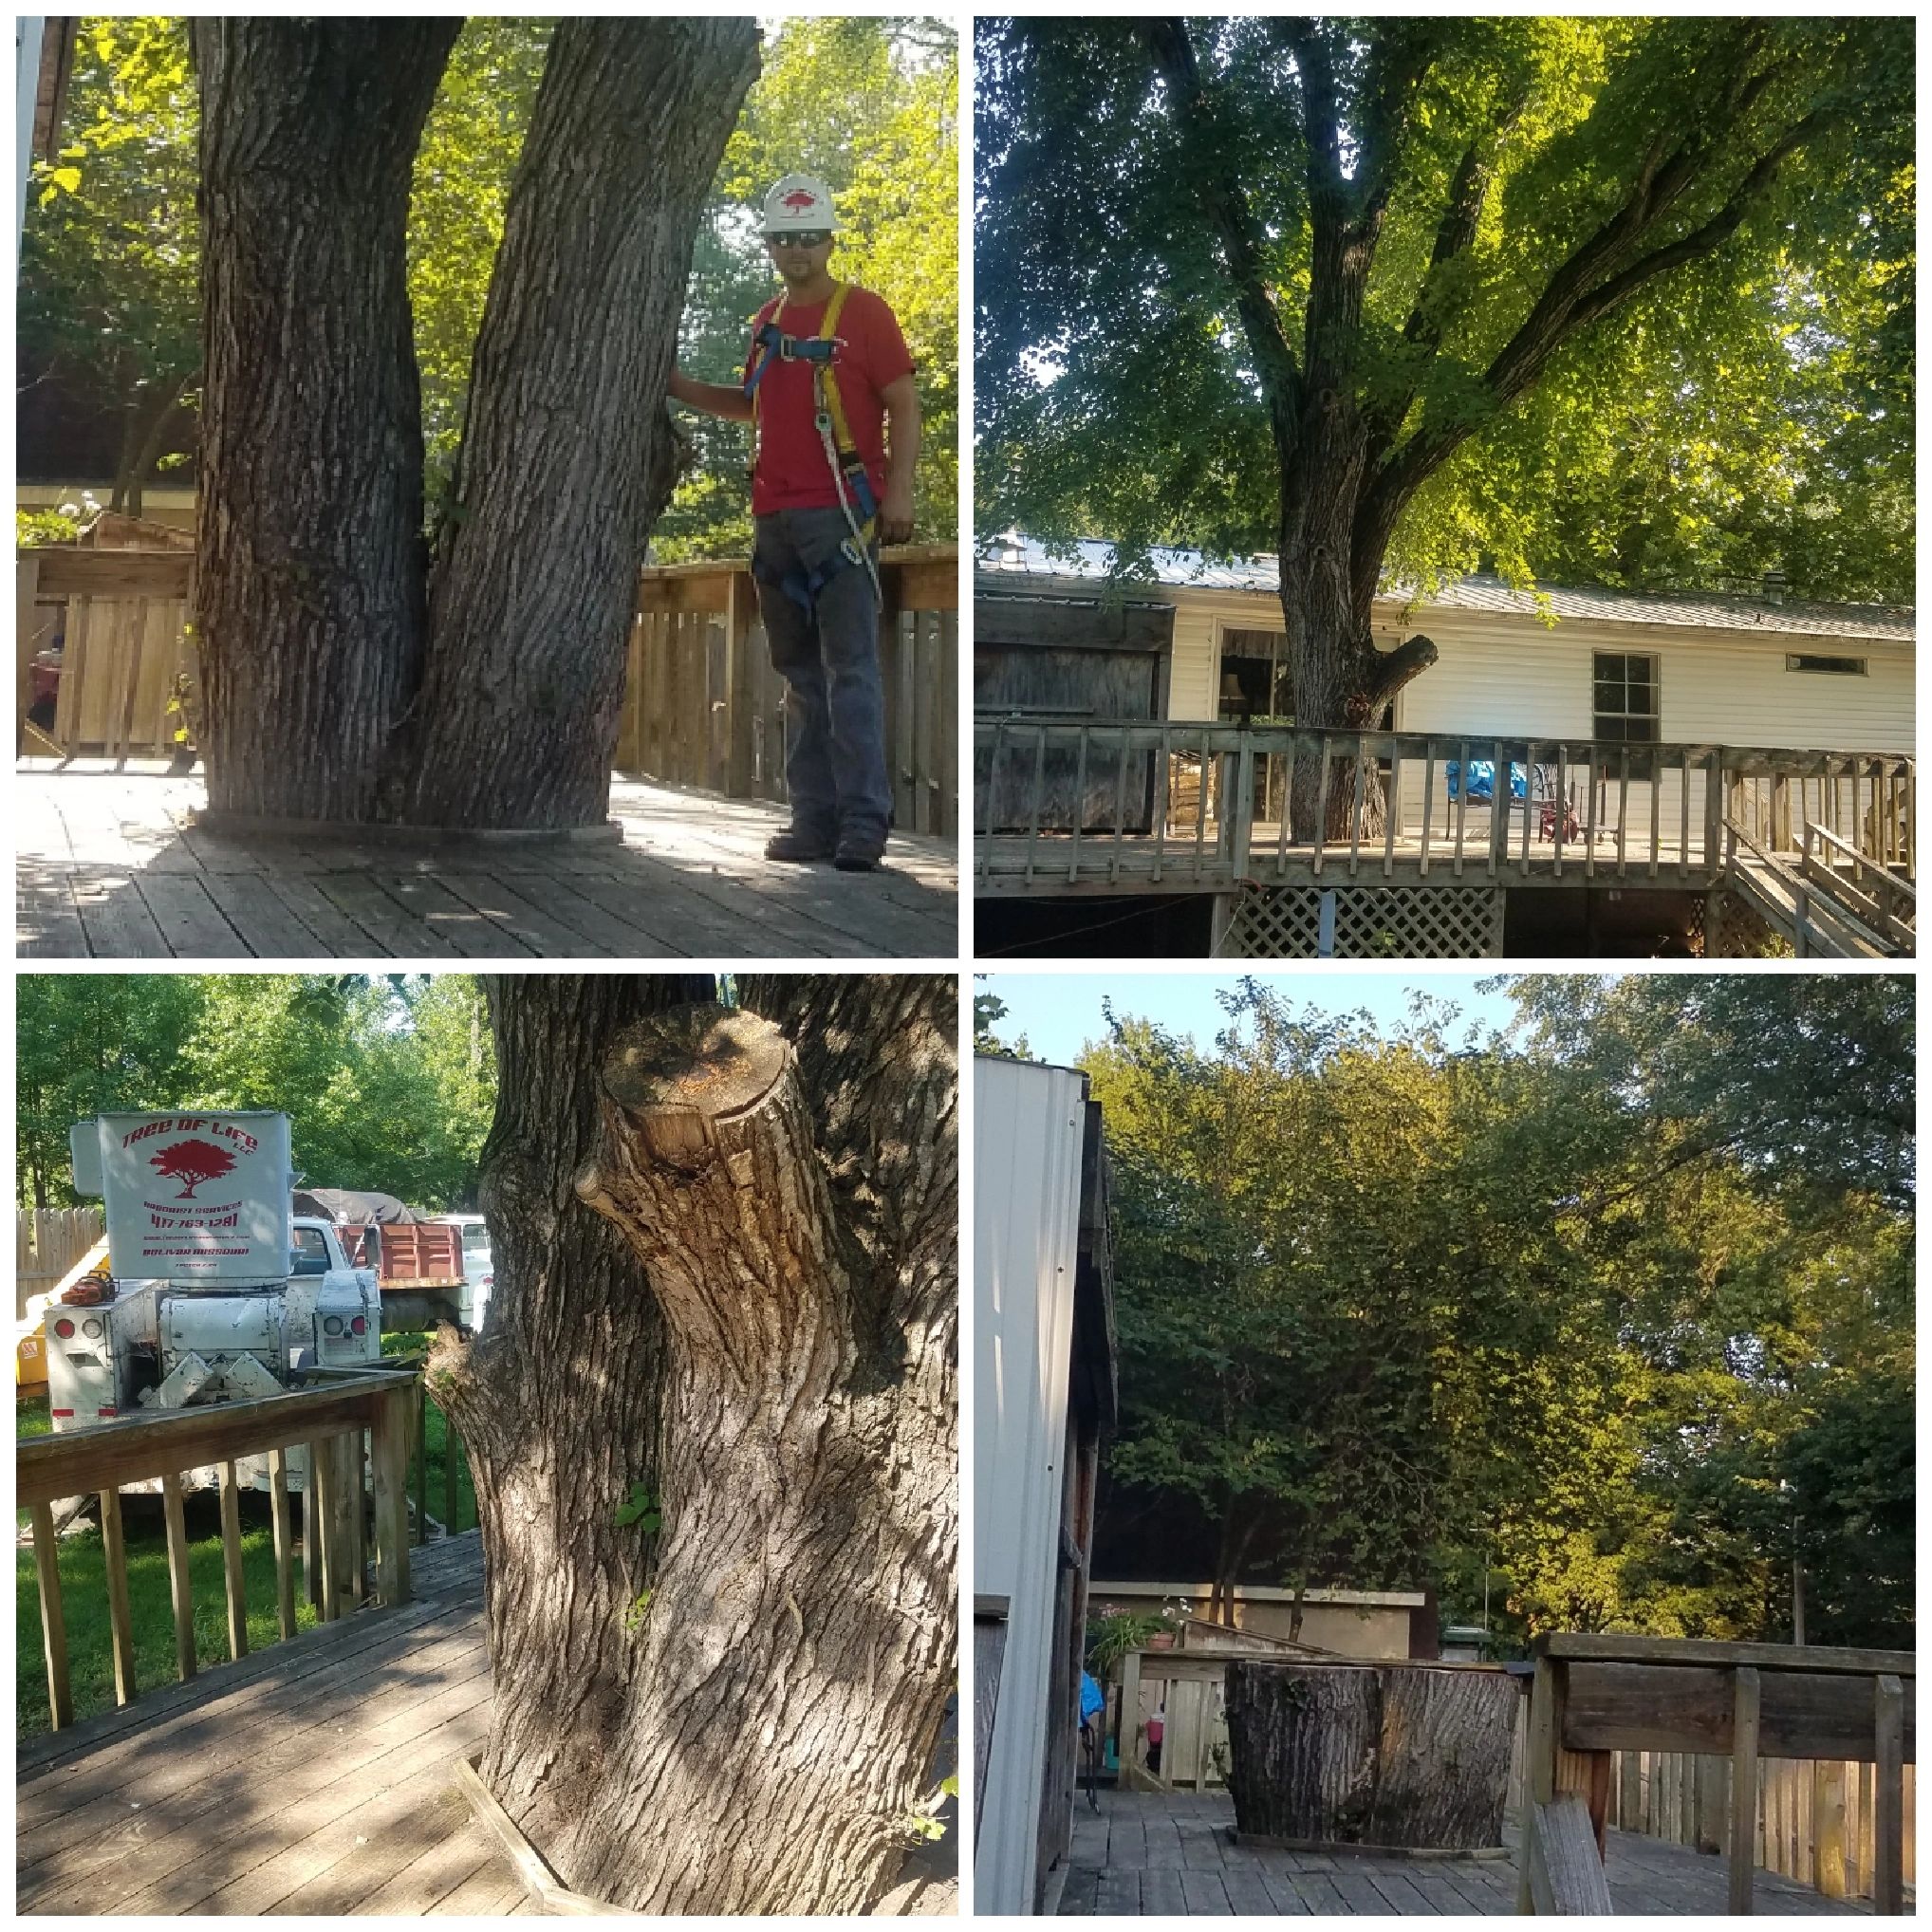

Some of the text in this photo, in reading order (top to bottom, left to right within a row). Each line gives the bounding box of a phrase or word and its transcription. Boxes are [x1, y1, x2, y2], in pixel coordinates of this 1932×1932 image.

[122, 1118, 258, 1151] TREE OF LIFE
